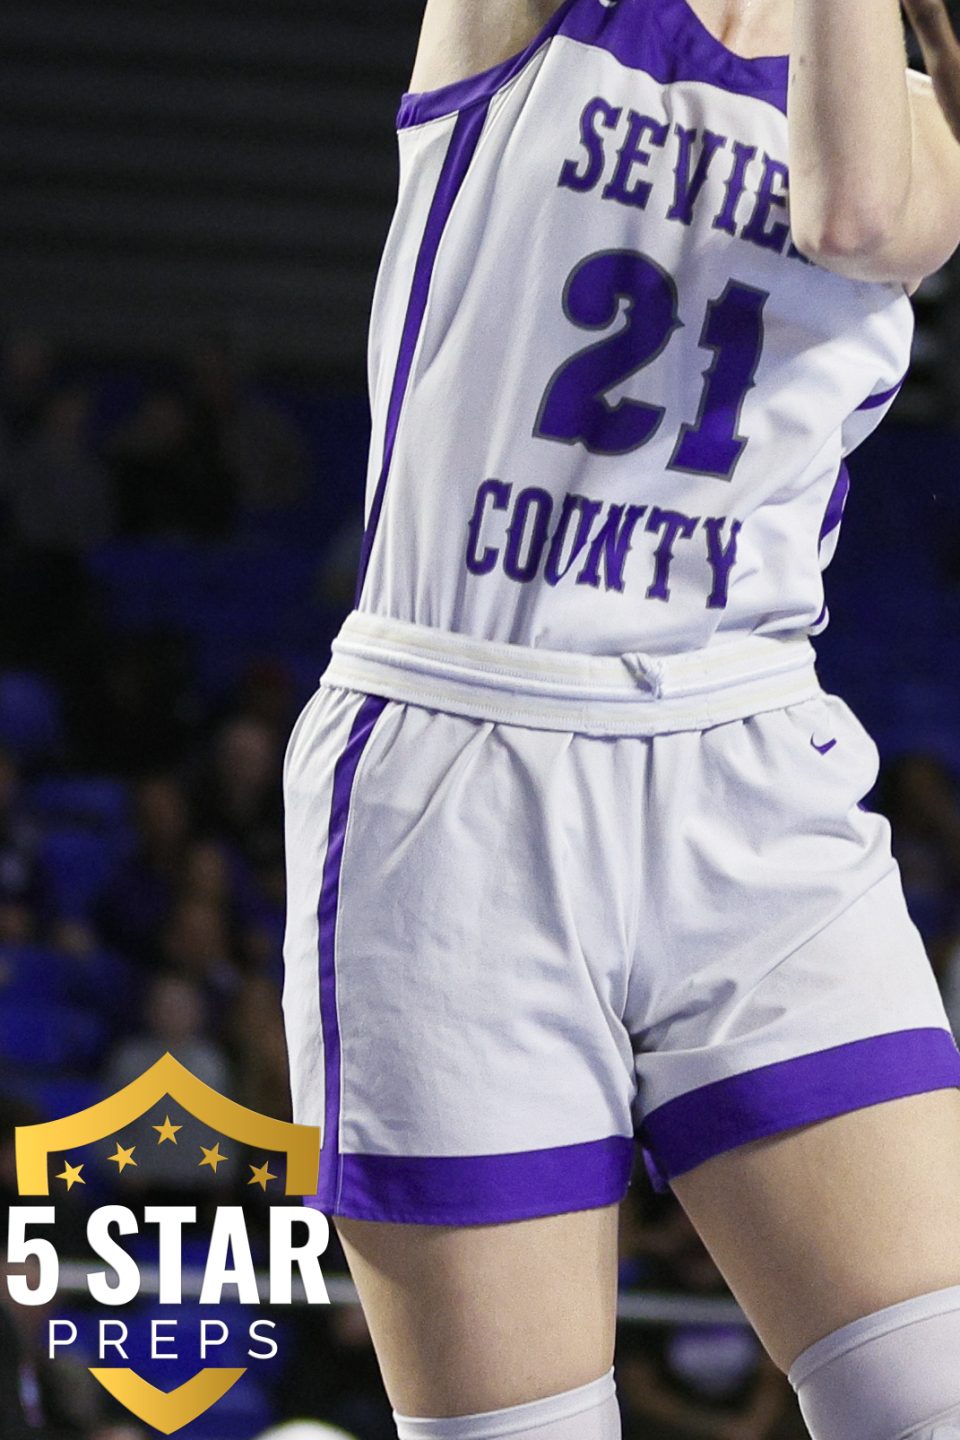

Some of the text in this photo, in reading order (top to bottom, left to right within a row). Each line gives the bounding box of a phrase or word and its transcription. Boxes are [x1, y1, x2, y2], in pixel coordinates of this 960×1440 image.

[557, 97, 814, 265] SEVIE
[533, 248, 770, 482] 21
[465, 479, 741, 608] COUNTY
